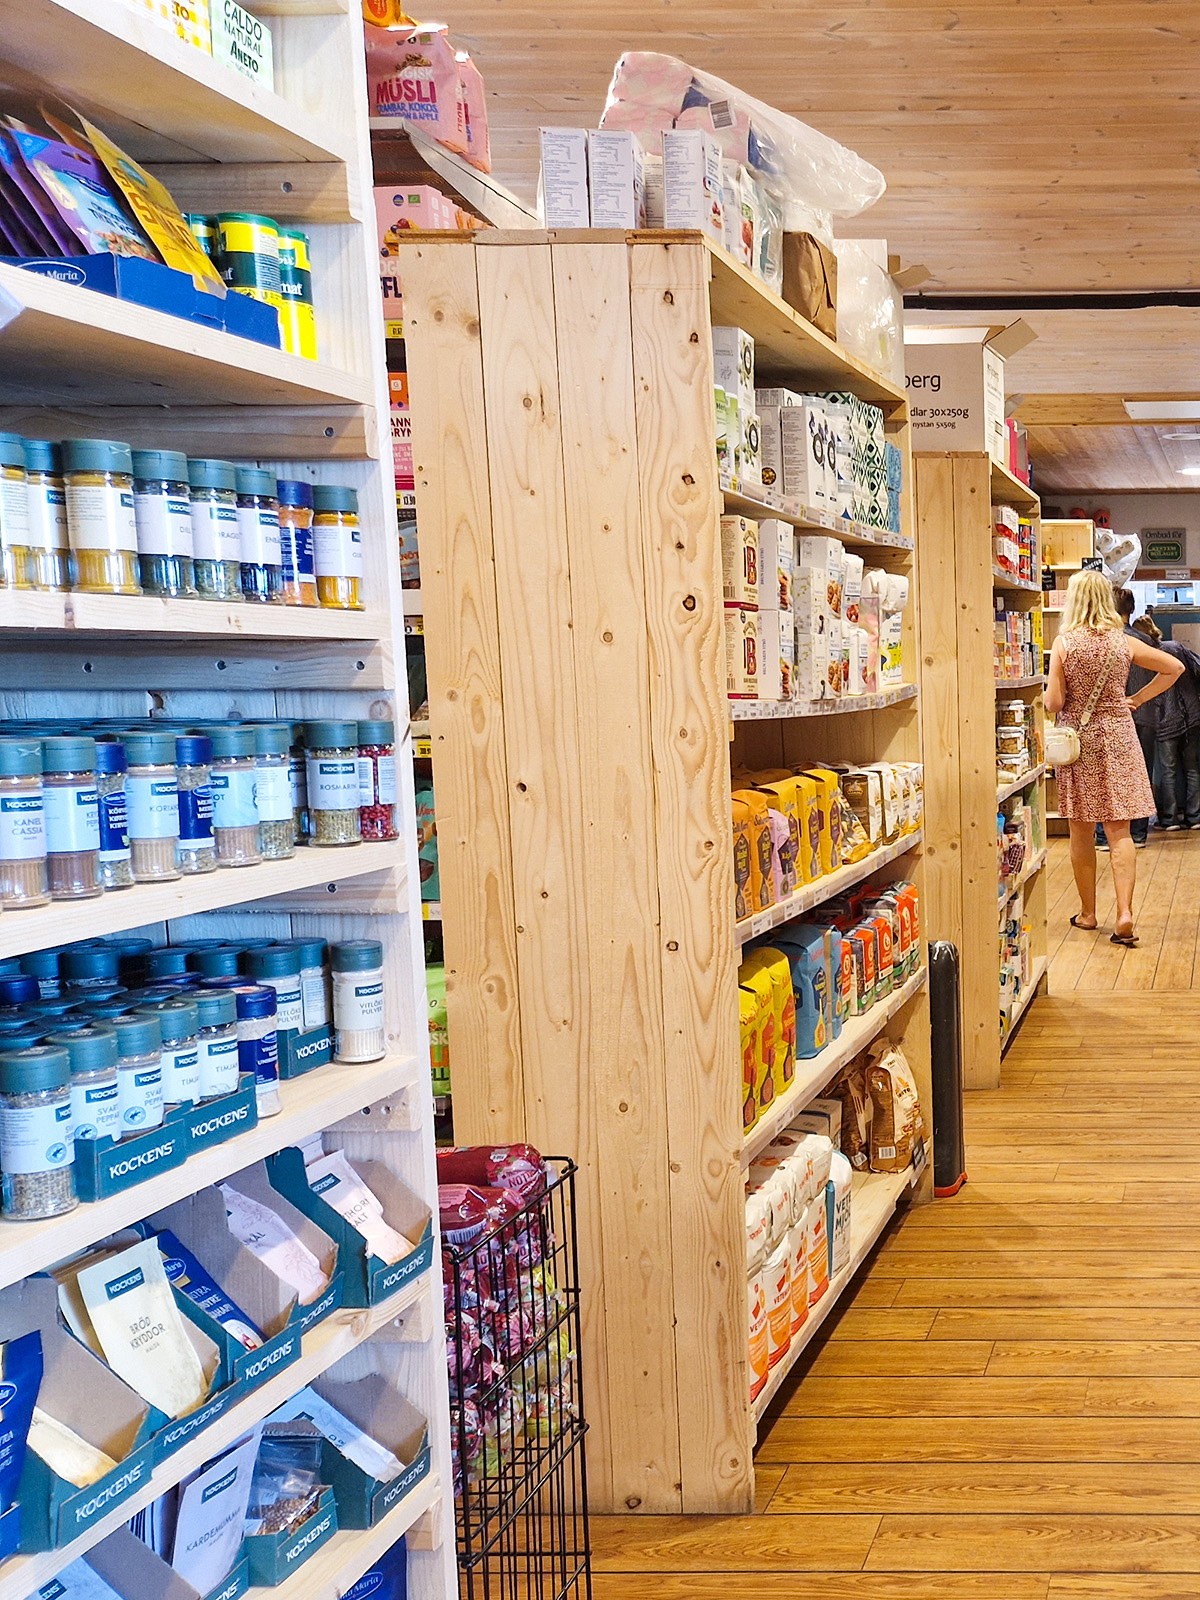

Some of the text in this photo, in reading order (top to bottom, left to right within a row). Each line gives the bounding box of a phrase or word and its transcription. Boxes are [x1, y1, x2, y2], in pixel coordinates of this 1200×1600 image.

[223, 0, 263, 41] CALDO
[223, 20, 263, 58] NATURAL
[230, 41, 259, 73] ANETO
[376, 78, 437, 105] MÜSLI
[909, 407, 969, 419] dlar 30x250g
[319, 783, 357, 792] ROSMARIN
[11, 827, 43, 836] CASSIA
[13, 817, 42, 828] KANEL
[190, 1107, 249, 1139] KOCKENS
[109, 1141, 174, 1180] KOCKENS
[109, 1271, 143, 1295] KOCKENS
[382, 1252, 426, 1290] KOCKENS
[129, 1314, 152, 1335] BRÖD
[301, 1292, 337, 1329] OCKENS
[129, 1322, 166, 1351] KRYDDOR
[244, 1340, 293, 1381] KOCKENS
[162, 1398, 227, 1448] KOCKENS
[74, 1463, 144, 1523] KOCKENS
[203, 1473, 238, 1498] KOCKENS
[384, 1458, 426, 1507] KOCKENS
[286, 1517, 332, 1563] KOCKENS
